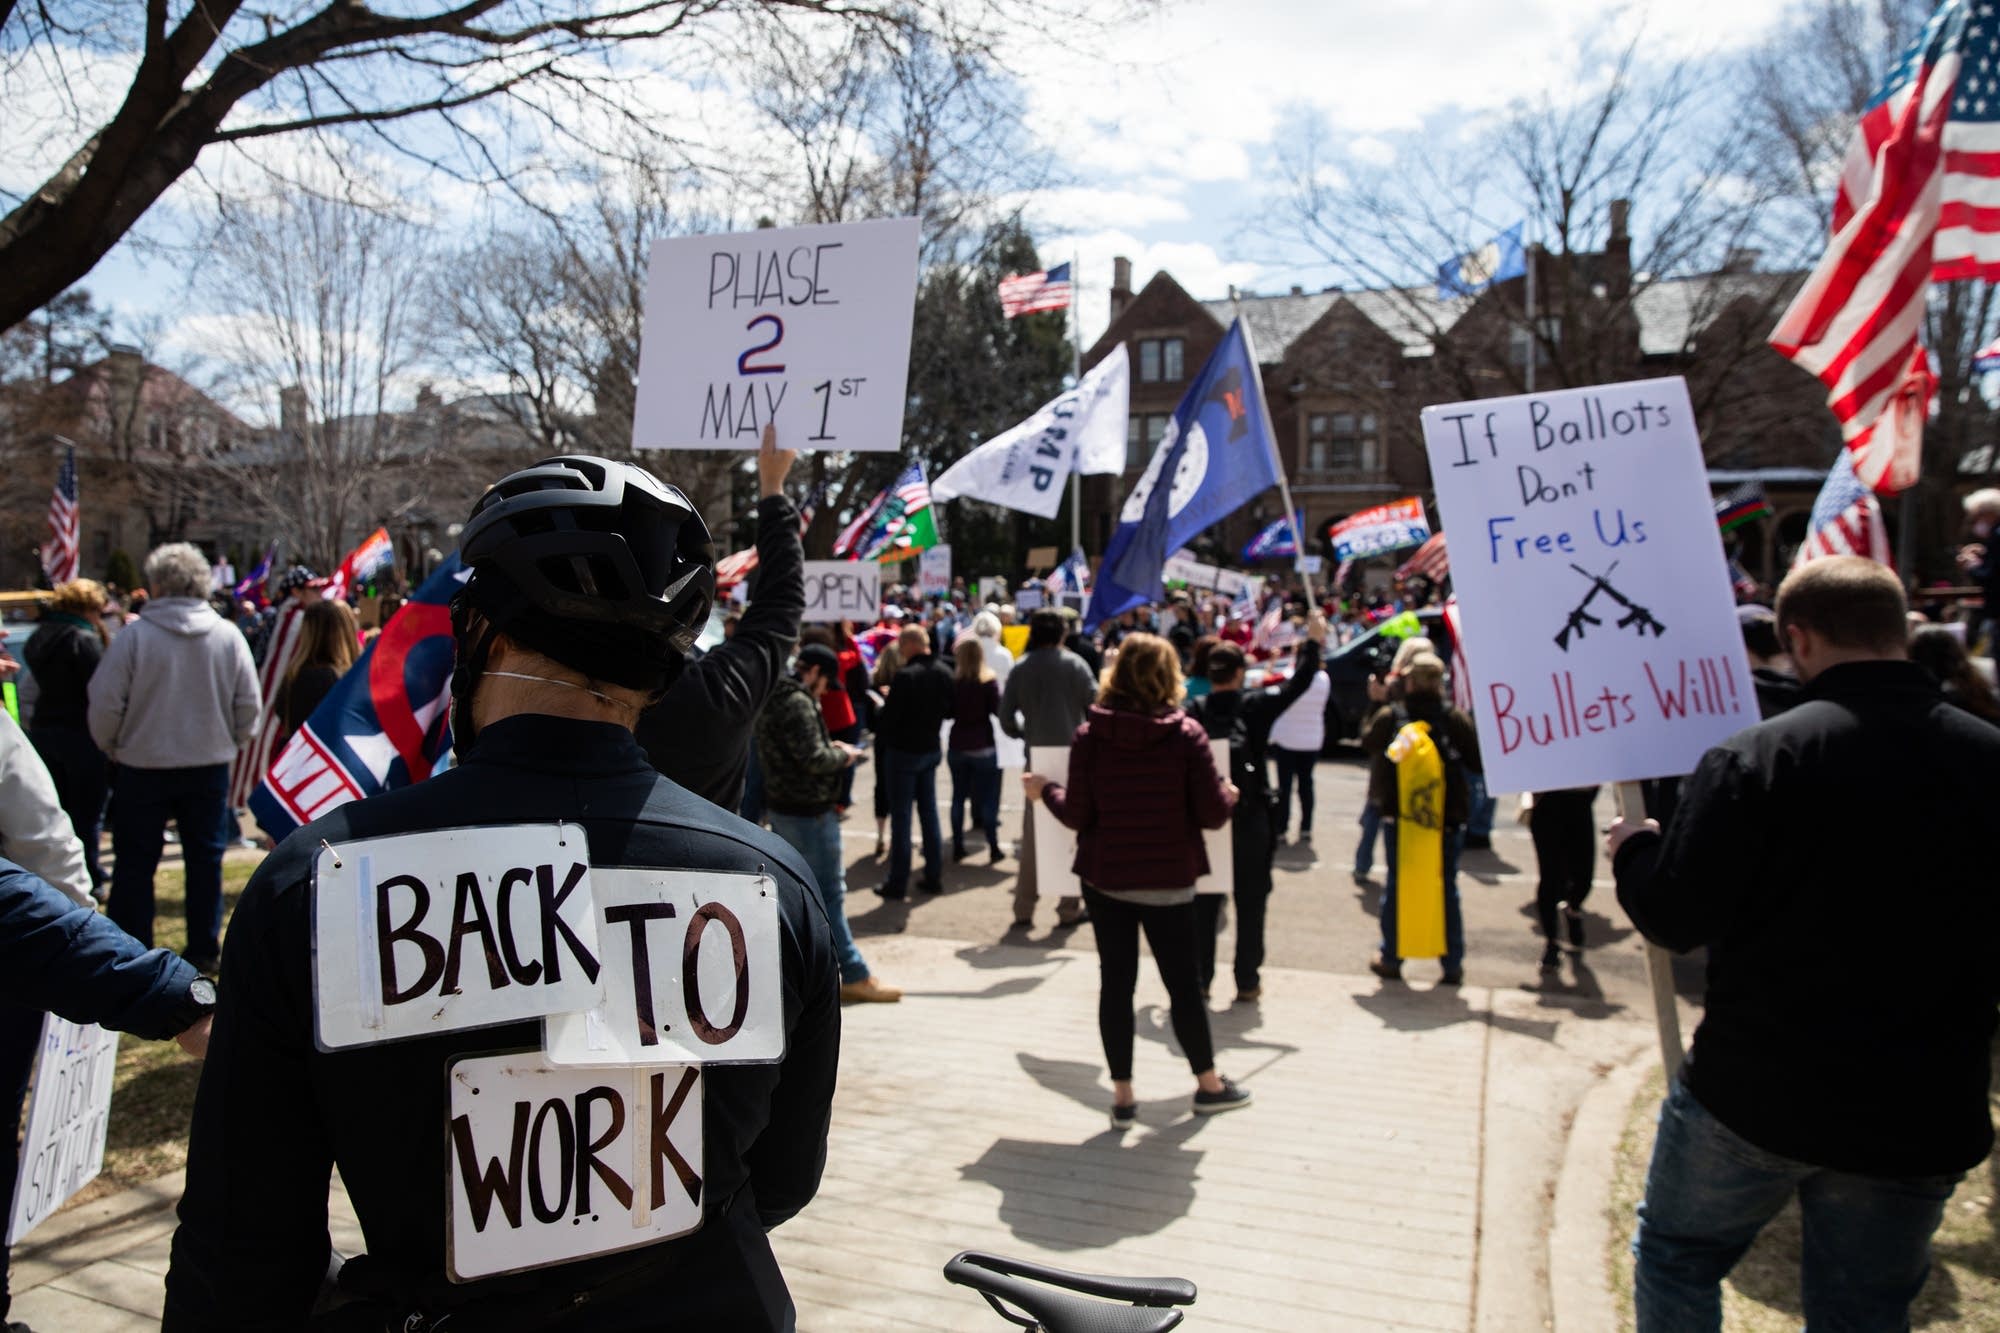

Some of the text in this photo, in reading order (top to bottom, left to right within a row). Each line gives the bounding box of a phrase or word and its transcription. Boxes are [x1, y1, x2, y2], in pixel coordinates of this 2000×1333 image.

[708, 243, 843, 309] PHASE
[737, 313, 786, 376] 2
[700, 381, 788, 439] MAY
[1441, 397, 1672, 468] If Ballots
[1517, 461, 1596, 507] Don't
[1488, 509, 1648, 564] Free Us
[803, 572, 877, 611] OPEN
[1489, 655, 1741, 755] Bullets Will!
[376, 861, 750, 1046] BACK TO
[451, 1065, 703, 1234] WORK
